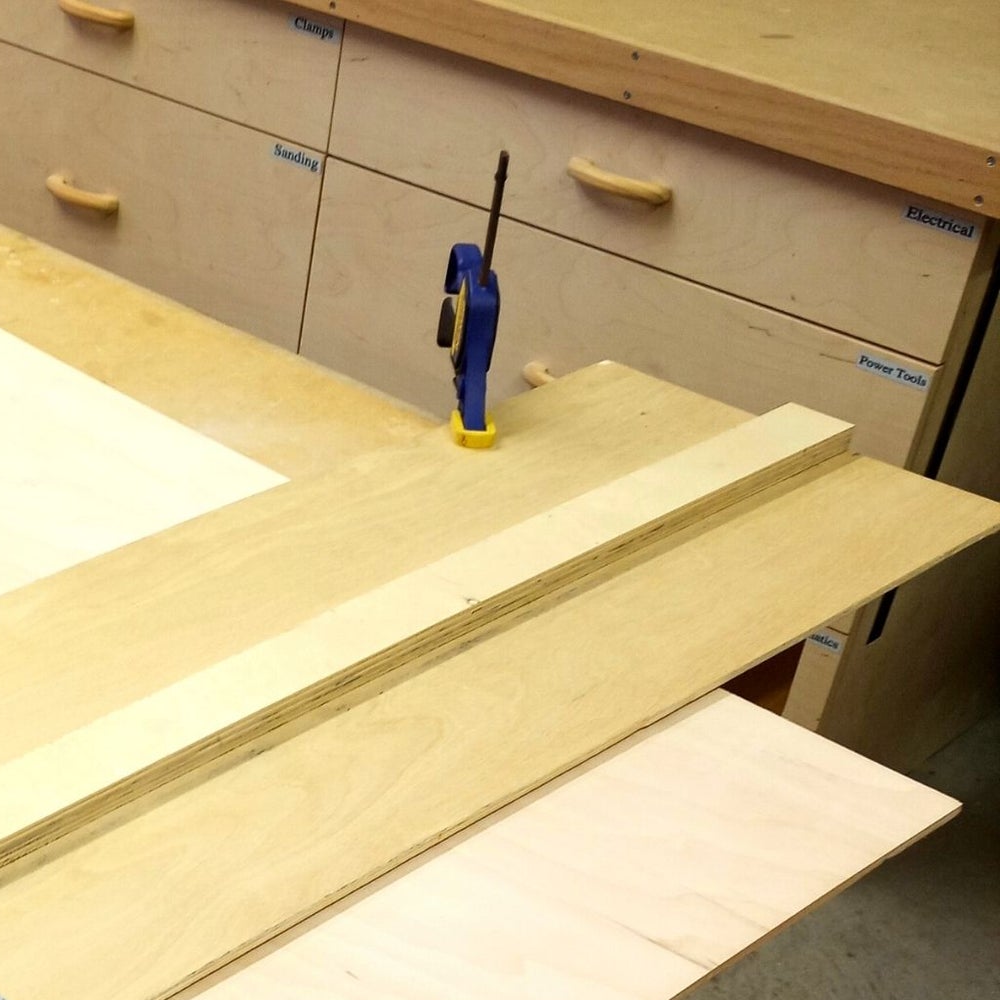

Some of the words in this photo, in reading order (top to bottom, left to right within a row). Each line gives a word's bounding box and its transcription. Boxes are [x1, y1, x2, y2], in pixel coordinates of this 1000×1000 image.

[294, 16, 334, 40] Clamps
[273, 143, 319, 172] Sanding
[906, 206, 975, 238] Electrical
[859, 355, 894, 375] Power
[896, 368, 927, 387] Tools
